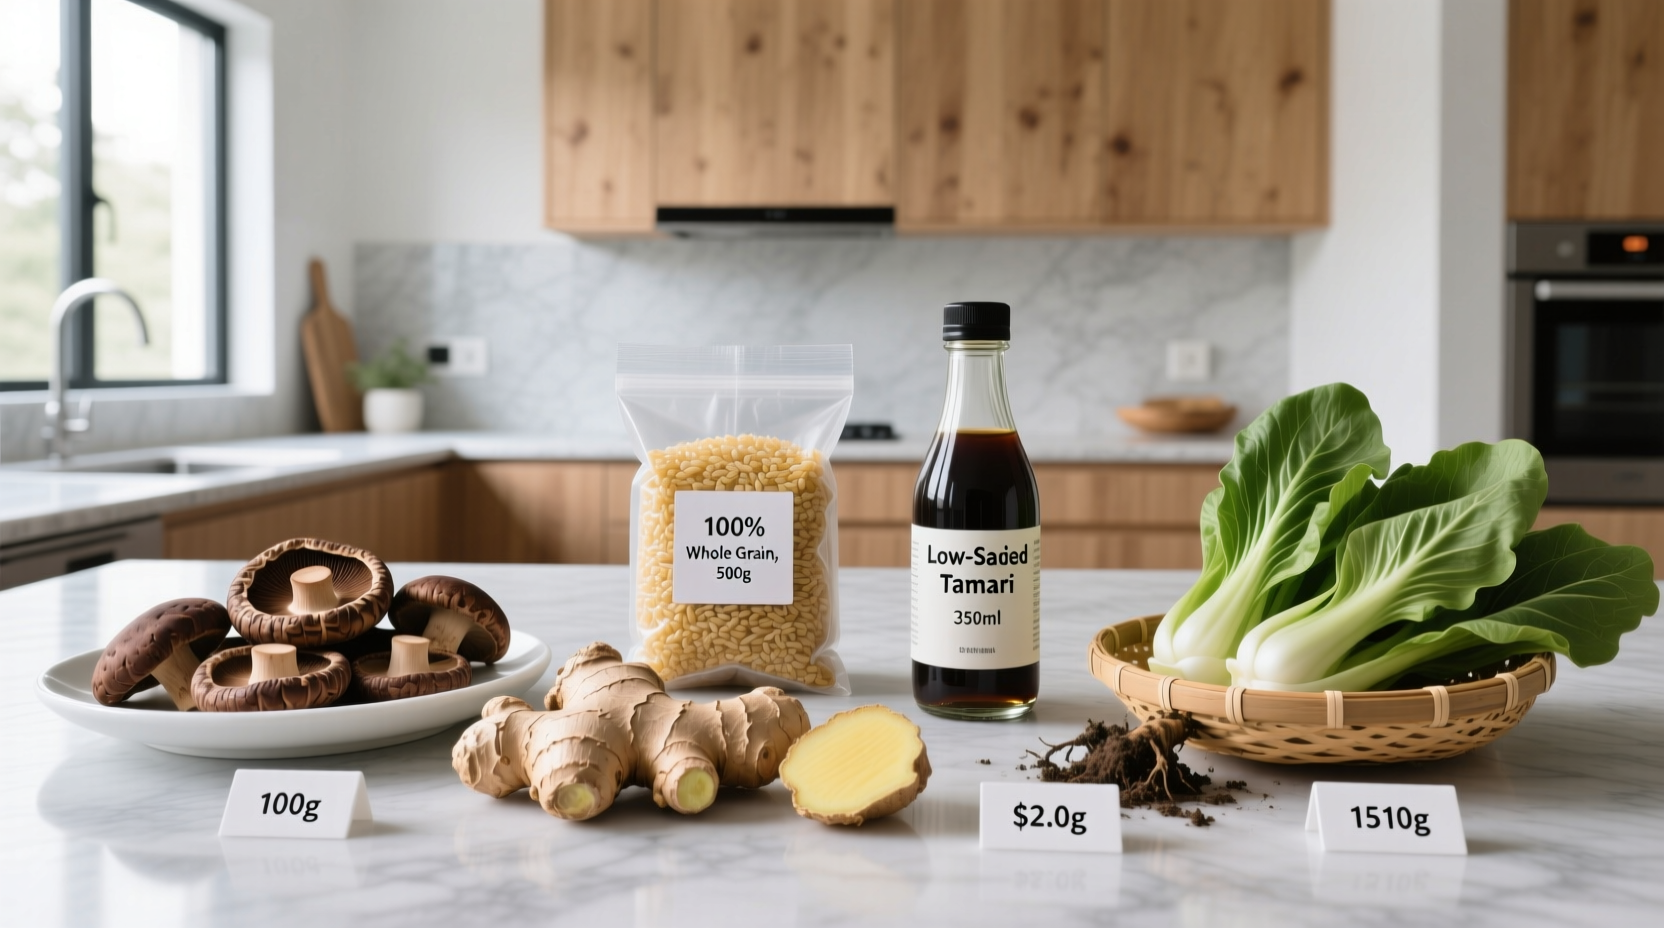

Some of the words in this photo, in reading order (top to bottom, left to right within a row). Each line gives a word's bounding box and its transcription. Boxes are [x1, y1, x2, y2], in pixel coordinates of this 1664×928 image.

[704, 516, 765, 537] 100%
[686, 545, 732, 560] Whole
[735, 545, 779, 564] Grain,
[716, 566, 752, 584] 500g
[940, 573, 1015, 594] Tamari
[953, 609, 1001, 625] 350ml
[261, 791, 322, 823] 100g
[1013, 801, 1088, 836] $2.0g
[1350, 805, 1432, 837] 1510g
